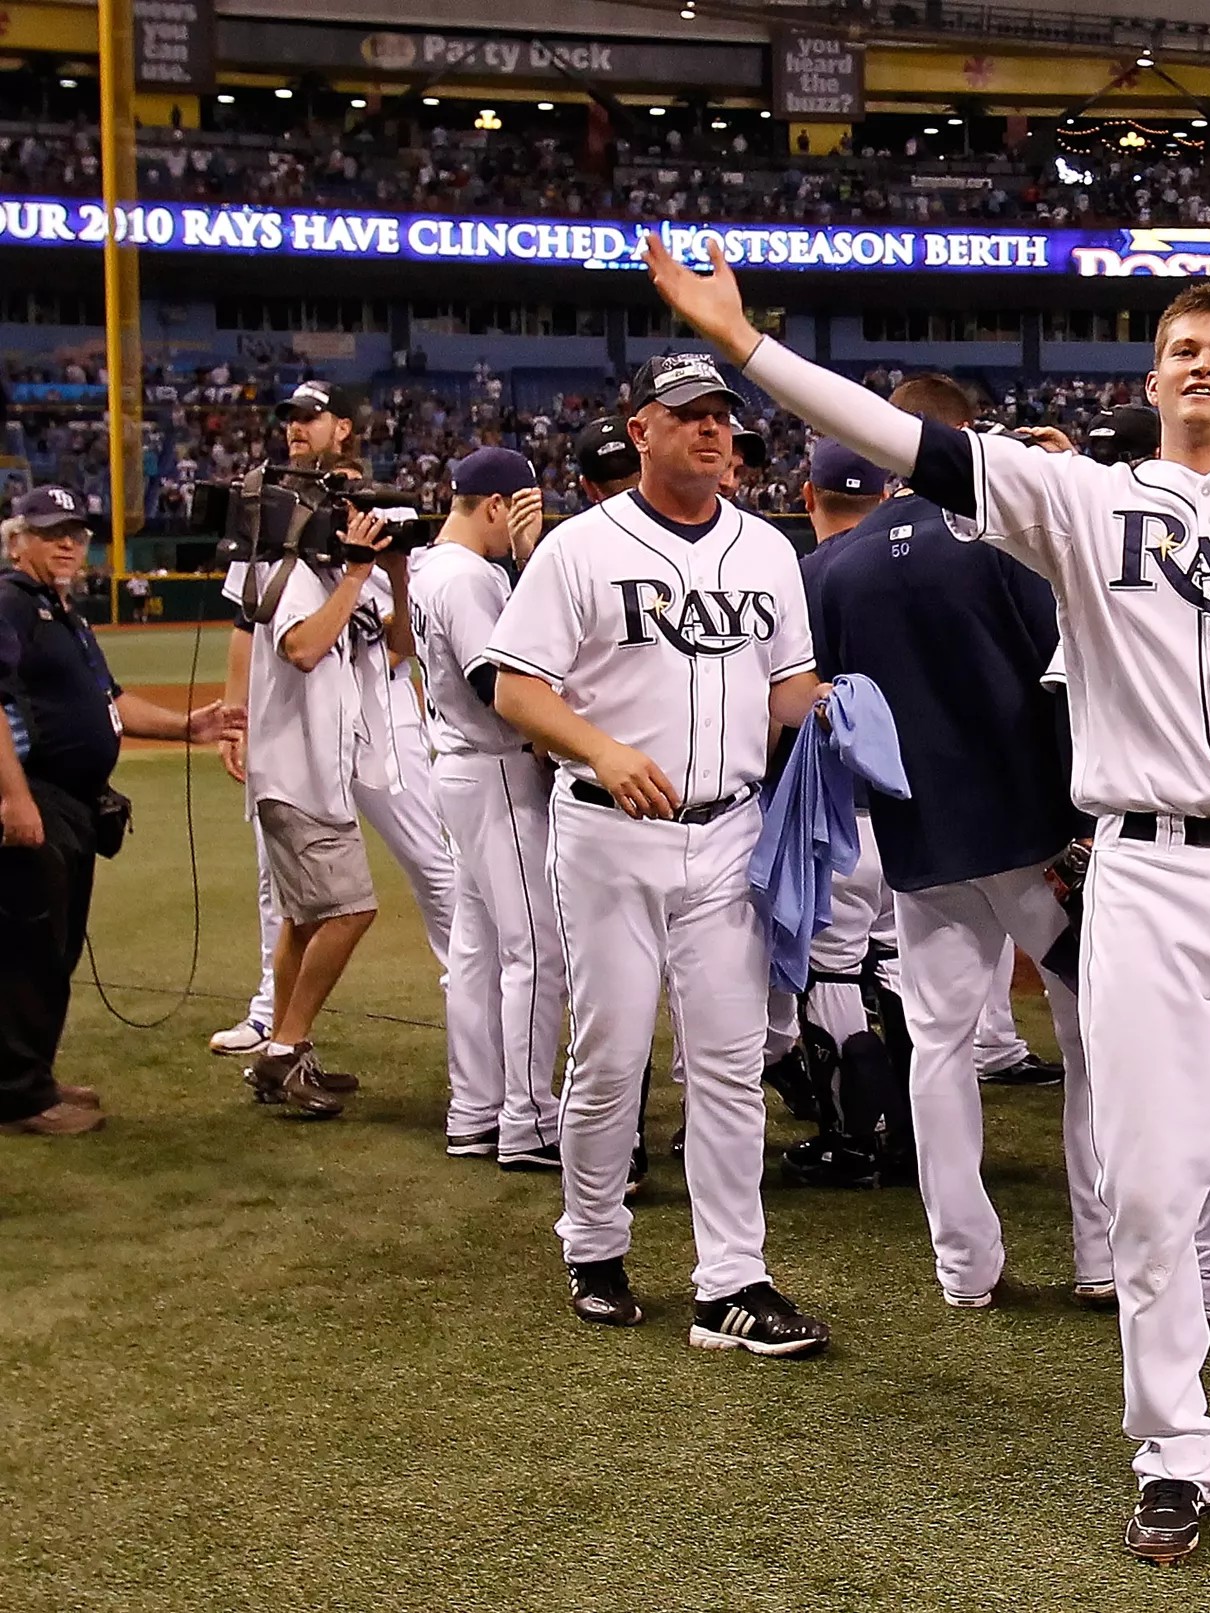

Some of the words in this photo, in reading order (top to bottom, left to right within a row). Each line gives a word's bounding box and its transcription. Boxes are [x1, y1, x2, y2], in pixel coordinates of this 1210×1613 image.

[798, 38, 839, 57] you
[786, 52, 853, 74] heard
[800, 72, 840, 93] the
[0, 201, 76, 241] UR
[182, 208, 283, 249] RAYS
[291, 213, 400, 254] HAVE
[407, 219, 626, 262] CLINCHED
[669, 227, 915, 266] POSTSEASON
[924, 233, 1049, 267] BERTH
[48, 489, 75, 510] TB
[891, 542, 910, 558] 50
[611, 578, 776, 657] RAYS
